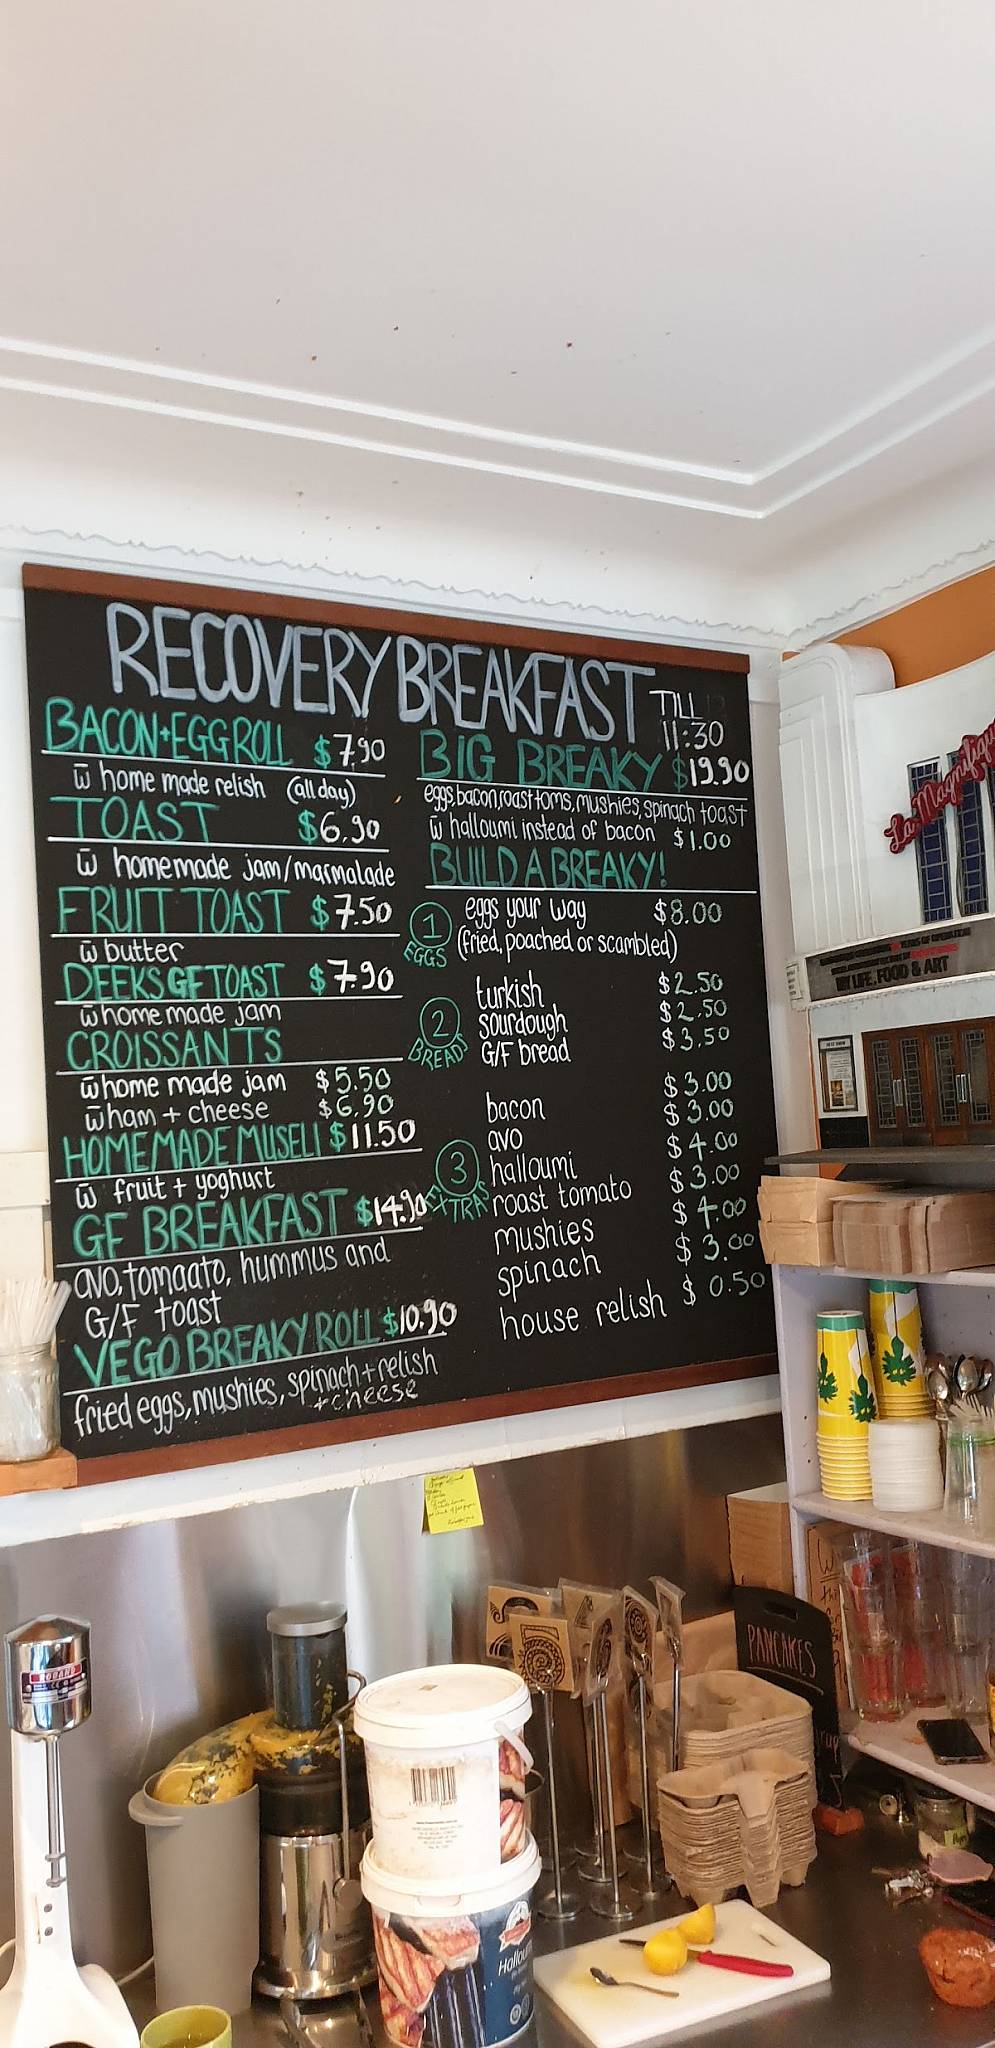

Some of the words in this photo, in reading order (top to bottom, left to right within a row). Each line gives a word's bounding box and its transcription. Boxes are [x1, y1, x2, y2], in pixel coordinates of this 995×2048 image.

[107, 602, 391, 718] RECOVERY
[397, 636, 655, 743] BREAKFAST
[649, 690, 703, 719] TILL
[313, 734, 385, 769] $7.90
[661, 720, 724, 751] 11:30
[99, 761, 154, 794] home
[162, 766, 209, 797] made
[215, 770, 267, 799] relish
[419, 729, 496, 781] BIG
[517, 739, 663, 792] BREAKY
[671, 752, 749, 793] $19.90
[885, 815, 915, 852] La
[911, 720, 995, 823] Magnifiqu
[49, 795, 219, 842] TOAST
[298, 809, 381, 844] $6.90
[449, 812, 518, 841] halloumi
[521, 817, 575, 842] instead
[581, 817, 598, 841] of
[605, 819, 656, 843] bacon
[643, 797, 695, 826] spinach
[700, 801, 748, 827] toast
[429, 842, 518, 888] BUILD
[524, 848, 545, 888] A
[551, 848, 667, 889] BREAKY!
[58, 884, 174, 935] FRUIT
[180, 886, 291, 935] TOAST
[309, 893, 393, 931] $7.50
[464, 896, 499, 930] eggs
[505, 895, 541, 930] your
[104, 938, 185, 964] butter
[403, 940, 448, 968] EGGS
[457, 924, 504, 962] (fried,
[505, 927, 574, 963] poached
[577, 934, 593, 951] or
[597, 928, 678, 964] scambled)
[63, 963, 165, 1001] DEEKS
[204, 962, 286, 999] TOAST
[309, 958, 395, 996] $7.90
[877, 962, 909, 984] FOOD
[924, 956, 949, 975] ART
[476, 970, 545, 1011] turkish
[101, 1003, 163, 1026] home
[166, 1001, 225, 1025] made
[234, 1001, 282, 1028] jam
[478, 1003, 568, 1041] sourdough
[66, 1026, 283, 1071] CROISSANTS
[481, 1041, 514, 1068] G/F
[518, 1038, 572, 1067] bread
[101, 1073, 160, 1100] home
[167, 1070, 233, 1097] made
[241, 1069, 287, 1098] jam
[105, 1105, 157, 1131] ham
[188, 1099, 270, 1123] cheese
[486, 1091, 546, 1124] bacon
[236, 1121, 321, 1164] MUSELI
[488, 1127, 523, 1153] avo
[113, 1176, 167, 1204] fruit
[195, 1166, 276, 1201] yoghurt
[490, 1150, 578, 1187] halloumi
[493, 1185, 549, 1218] roast
[558, 1173, 632, 1209] tomato
[73, 1211, 129, 1259] GF
[143, 1188, 348, 1256] BREAKFAST
[494, 1216, 595, 1256] mushies
[239, 1245, 338, 1286] hummus
[345, 1236, 392, 1268] and
[498, 1246, 602, 1303] spinach
[85, 1302, 141, 1340] G/F
[155, 1290, 223, 1332] toast
[499, 1306, 580, 1341] house
[595, 1278, 668, 1327] relish
[74, 1334, 181, 1388] VEGO
[186, 1316, 308, 1374] BREAKY
[313, 1307, 381, 1354] ROLL
[74, 1392, 132, 1438] fried
[136, 1396, 192, 1436] eggs,
[192, 1376, 287, 1419] mushies,
[747, 1624, 817, 1679] PANCAKES
